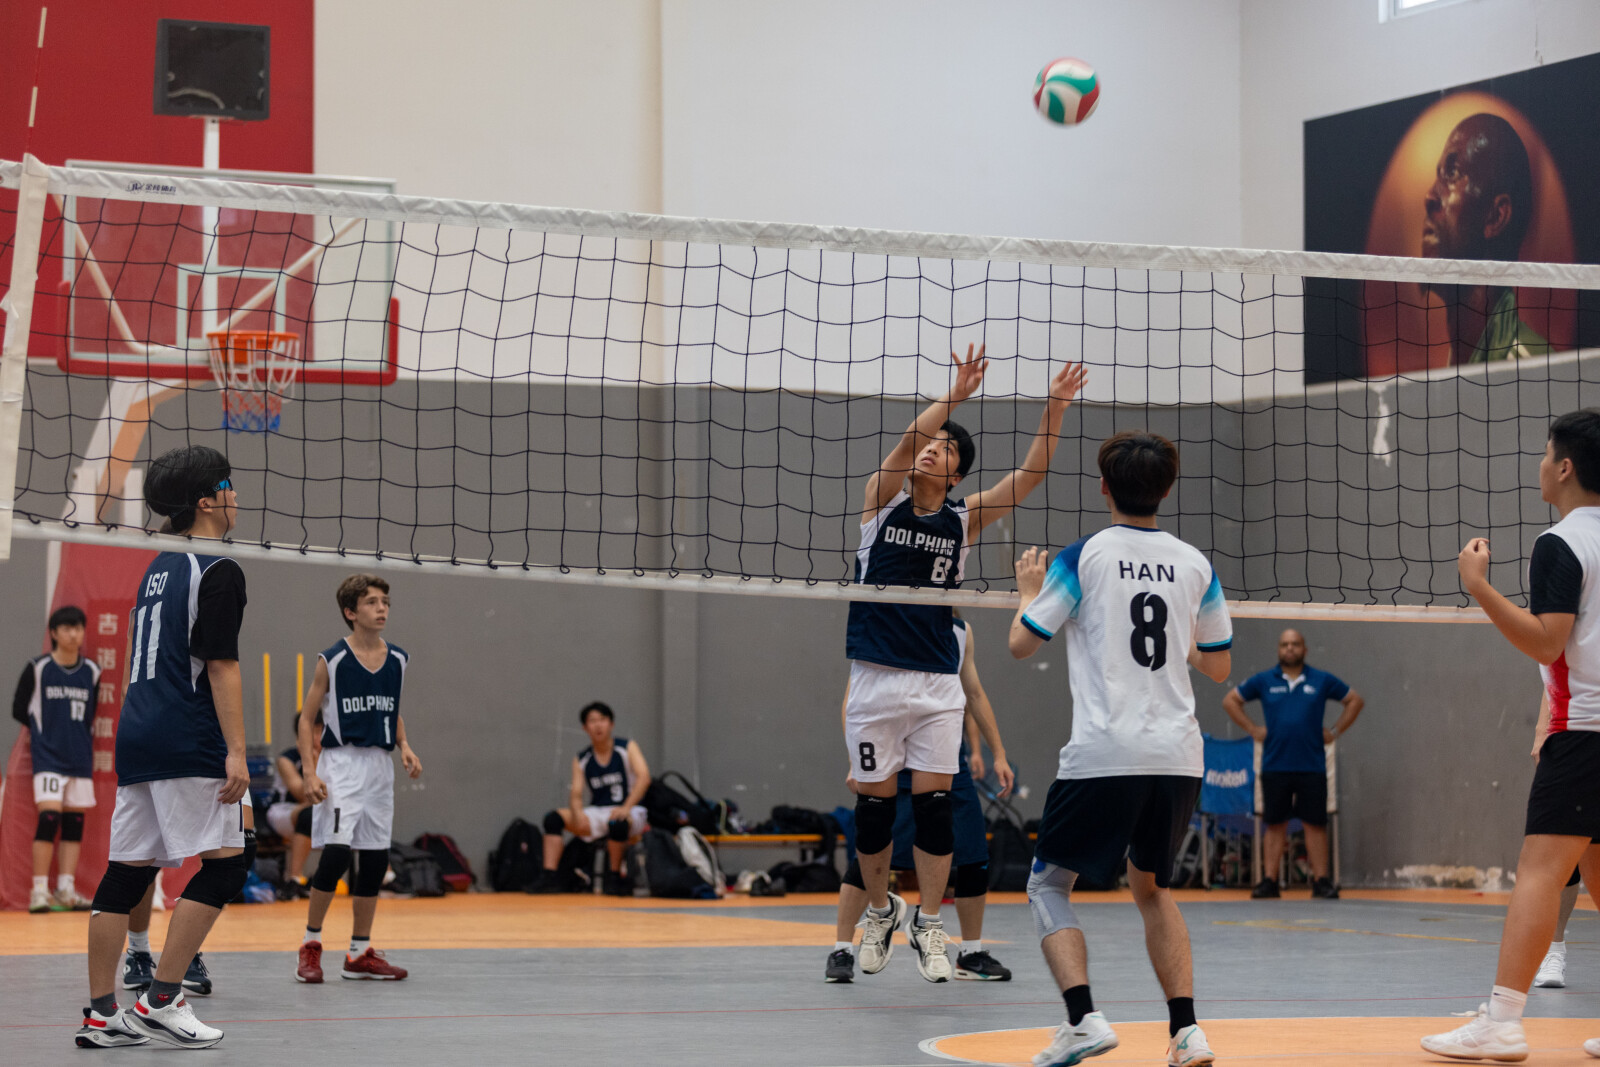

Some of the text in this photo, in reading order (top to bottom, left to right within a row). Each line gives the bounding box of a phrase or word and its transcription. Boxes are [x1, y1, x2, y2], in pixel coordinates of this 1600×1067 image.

[884, 526, 956, 556] DOLPHINS
[145, 571, 169, 598] ISO
[1119, 560, 1175, 583] HAN
[130, 600, 163, 684] 11
[1130, 591, 1168, 672] 8
[383, 716, 391, 744] 1
[859, 742, 876, 771] 8
[43, 776, 59, 793] 10
[333, 808, 341, 834] 1
